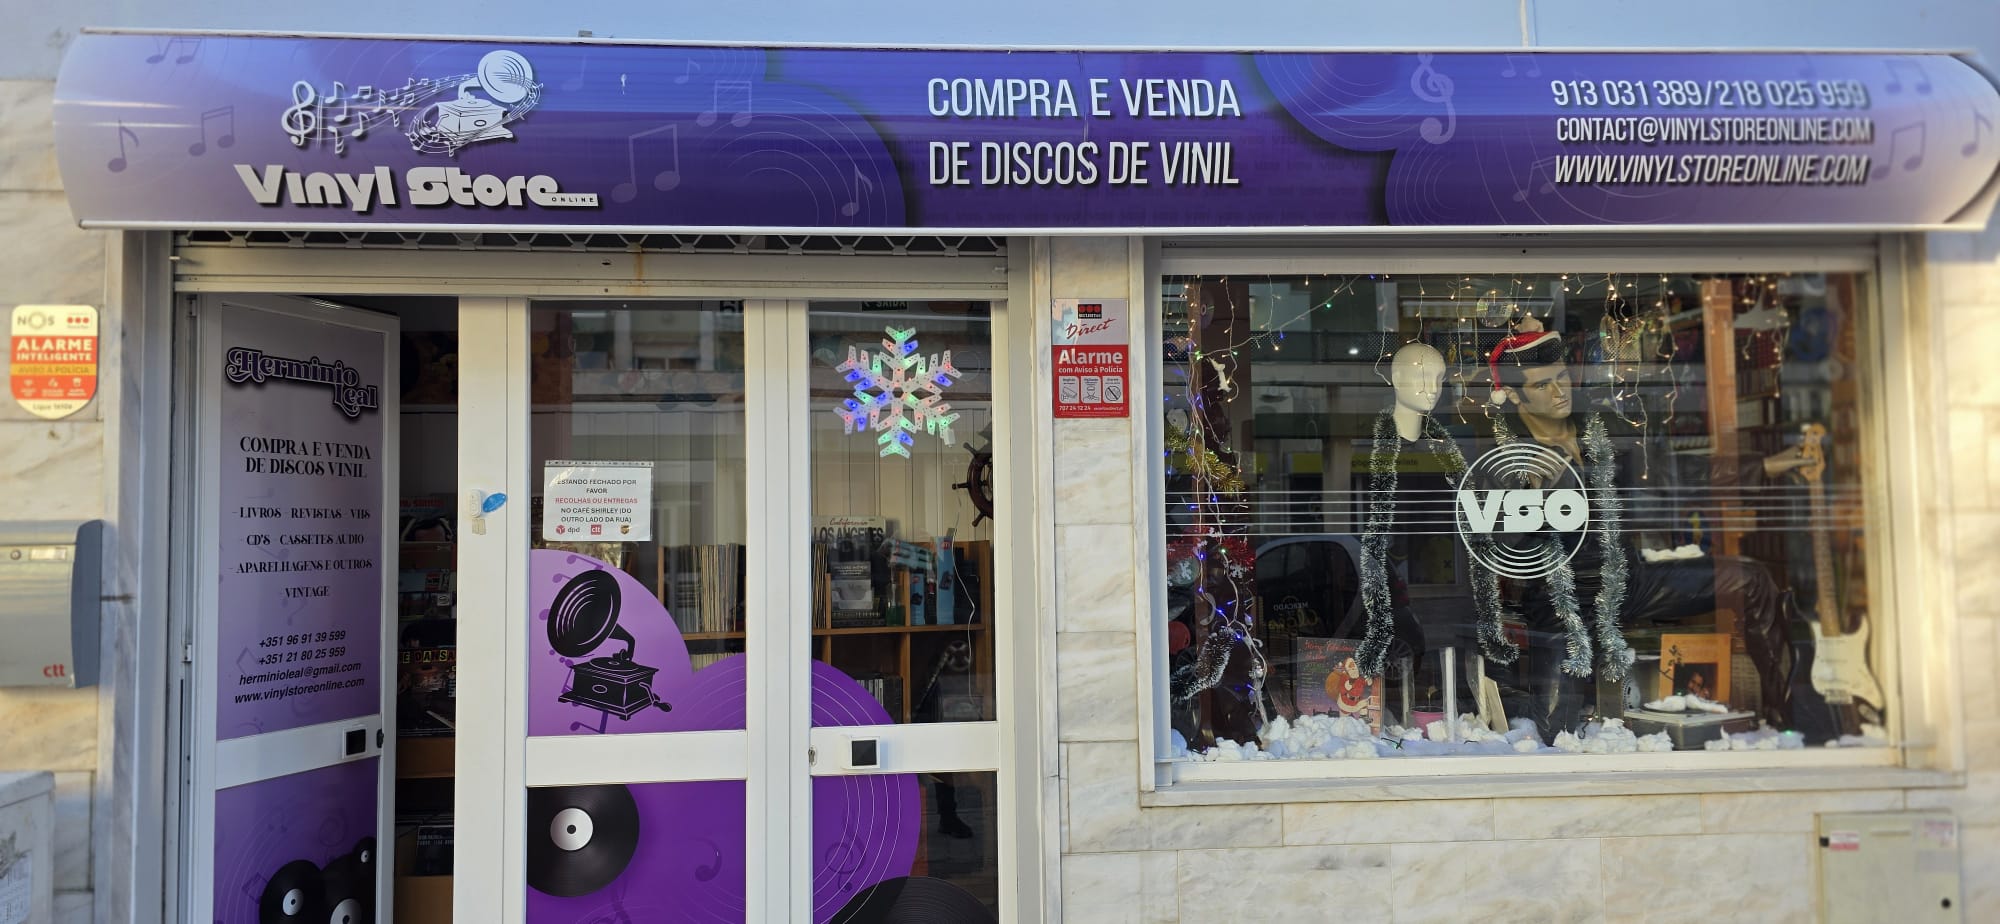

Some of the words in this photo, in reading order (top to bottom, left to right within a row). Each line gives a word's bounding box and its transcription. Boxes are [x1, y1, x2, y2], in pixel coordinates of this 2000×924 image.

[928, 78, 1077, 117] COMPRA
[1090, 78, 1111, 116] E
[1120, 79, 1240, 117] VENDA
[1551, 80, 1598, 105] 913
[1602, 80, 1648, 105] 031
[1653, 80, 1762, 106] 389/218
[1766, 80, 1814, 106] 025
[1818, 81, 1867, 107] 959
[1557, 117, 1871, 143] CONTACT@VINYLSTOREONLINE.COM
[930, 142, 970, 184] DE
[981, 142, 1098, 185] DISCOS
[1108, 142, 1149, 184] DE
[1160, 142, 1239, 184] VINIL
[1555, 155, 1868, 183] WWW.VINYLSTOREONLINE.COM
[234, 165, 396, 211] Vinyl
[406, 167, 562, 207] Store
[17, 311, 55, 330] NOS
[1066, 318, 1117, 339] Direct
[17, 338, 92, 351] ALARME
[16, 352, 92, 361] INTELIGENTE
[1059, 348, 1123, 364] Alarme
[226, 347, 360, 387] Herminio
[334, 383, 378, 418] Leal
[240, 436, 308, 455] COMPRA
[313, 441, 322, 456] E
[325, 442, 371, 459] VENDA
[246, 457, 265, 473] DE
[270, 458, 325, 475] DISCOS
[328, 461, 367, 478] VINIL
[240, 506, 282, 518] LIVROS
[291, 507, 342, 519] REVISTAS
[351, 508, 371, 519] VHS
[830, 516, 869, 527] California
[1458, 489, 1587, 533] VSO
[246, 534, 271, 545] CD'S
[280, 534, 334, 545] CASSETES
[335, 534, 364, 544] AUDIO
[568, 526, 580, 534] dpd
[236, 560, 323, 574] APARELHAGENS
[325, 560, 332, 570] E
[333, 559, 373, 570] OUTROS
[285, 586, 330, 598] VINTAGE
[259, 636, 283, 648] +351
[286, 635, 299, 645] 96
[301, 634, 312, 644] 91
[315, 632, 327, 642] 39
[329, 630, 346, 641] 599
[259, 653, 283, 665] +351
[286, 652, 298, 662] 21
[301, 650, 312, 661] 80
[315, 648, 327, 659] 25
[329, 647, 346, 658] 959
[43, 664, 66, 678] ctt
[239, 662, 361, 685] herminioleal@gmail.com
[235, 677, 365, 703] www.vinylstoreonline.com
